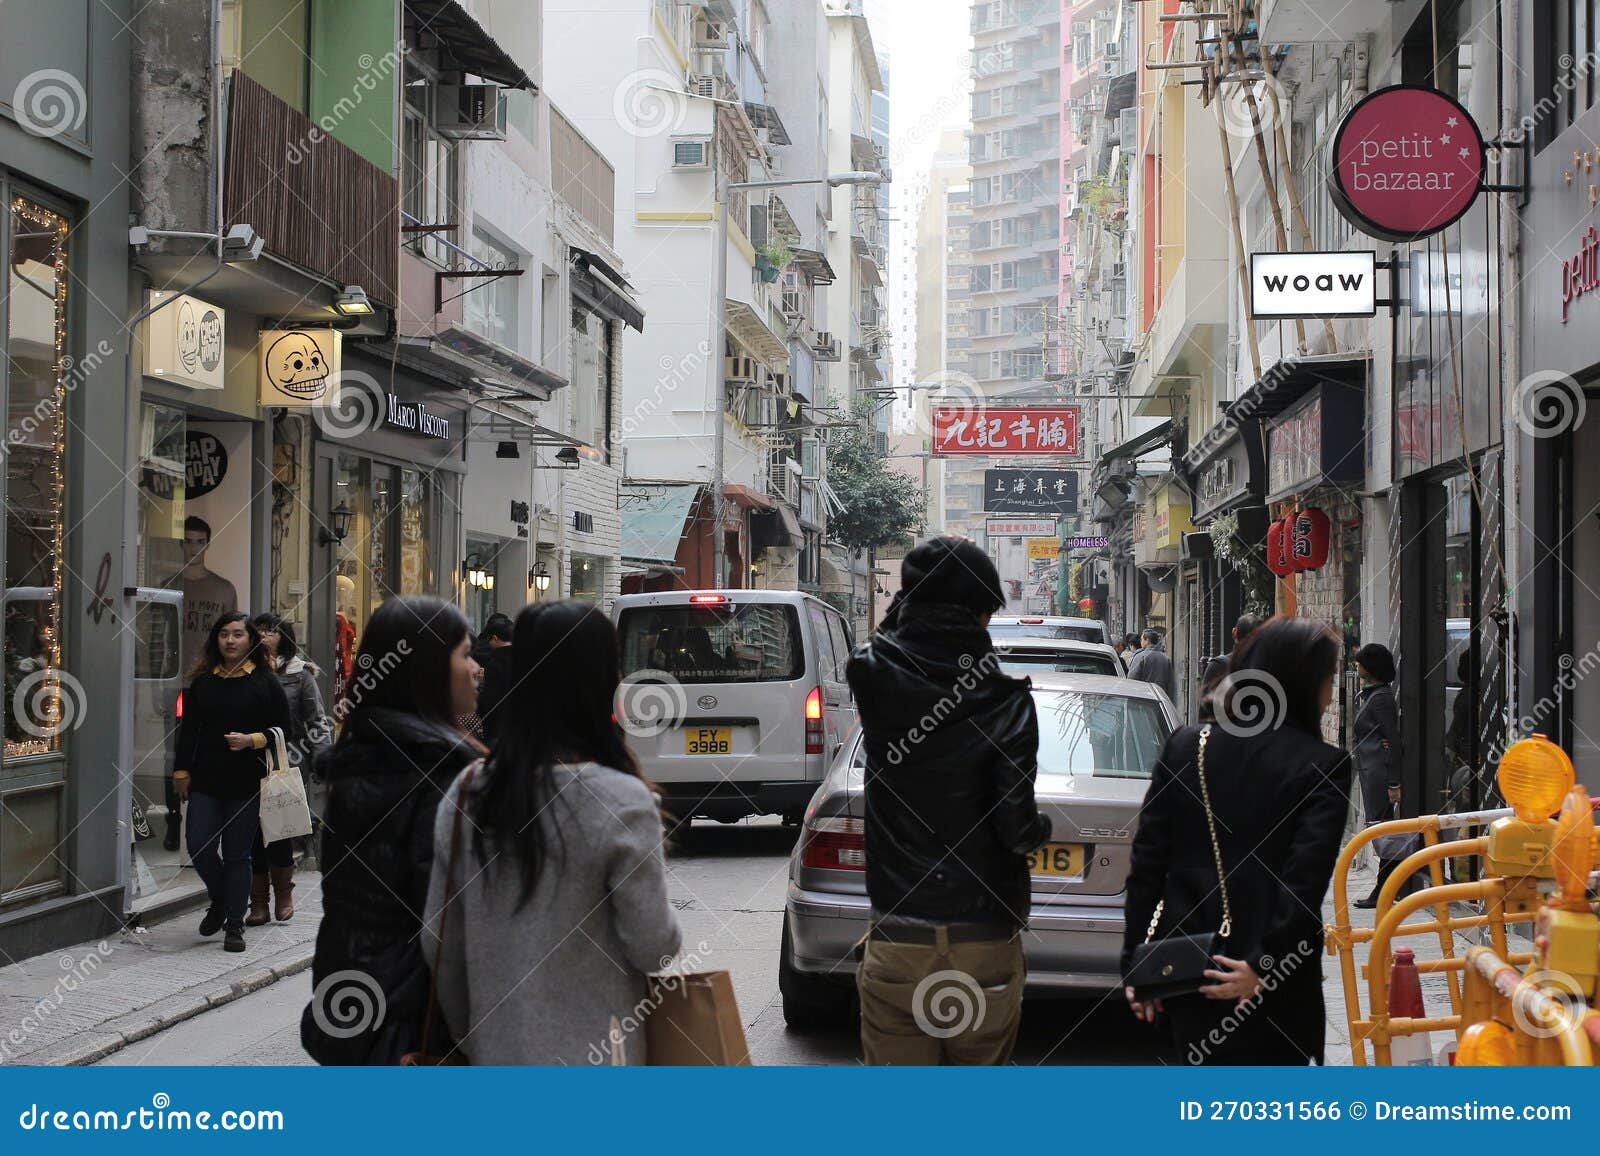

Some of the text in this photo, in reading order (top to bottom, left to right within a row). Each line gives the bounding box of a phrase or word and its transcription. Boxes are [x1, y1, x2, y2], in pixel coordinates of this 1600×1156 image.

[1360, 132, 1433, 166] petit
[1352, 161, 1454, 191] bazaar
[1263, 272, 1364, 292] woaw
[1560, 224, 1600, 324] petit
[388, 393, 449, 440] MARCO VISCONTI
[943, 414, 1068, 449] 九記牛腩
[157, 437, 217, 465] HEAP
[994, 477, 1068, 495] 上海弄堂
[1068, 537, 1109, 548] HOMELESS
[689, 741, 729, 753] 3988
[698, 729, 719, 742] FY
